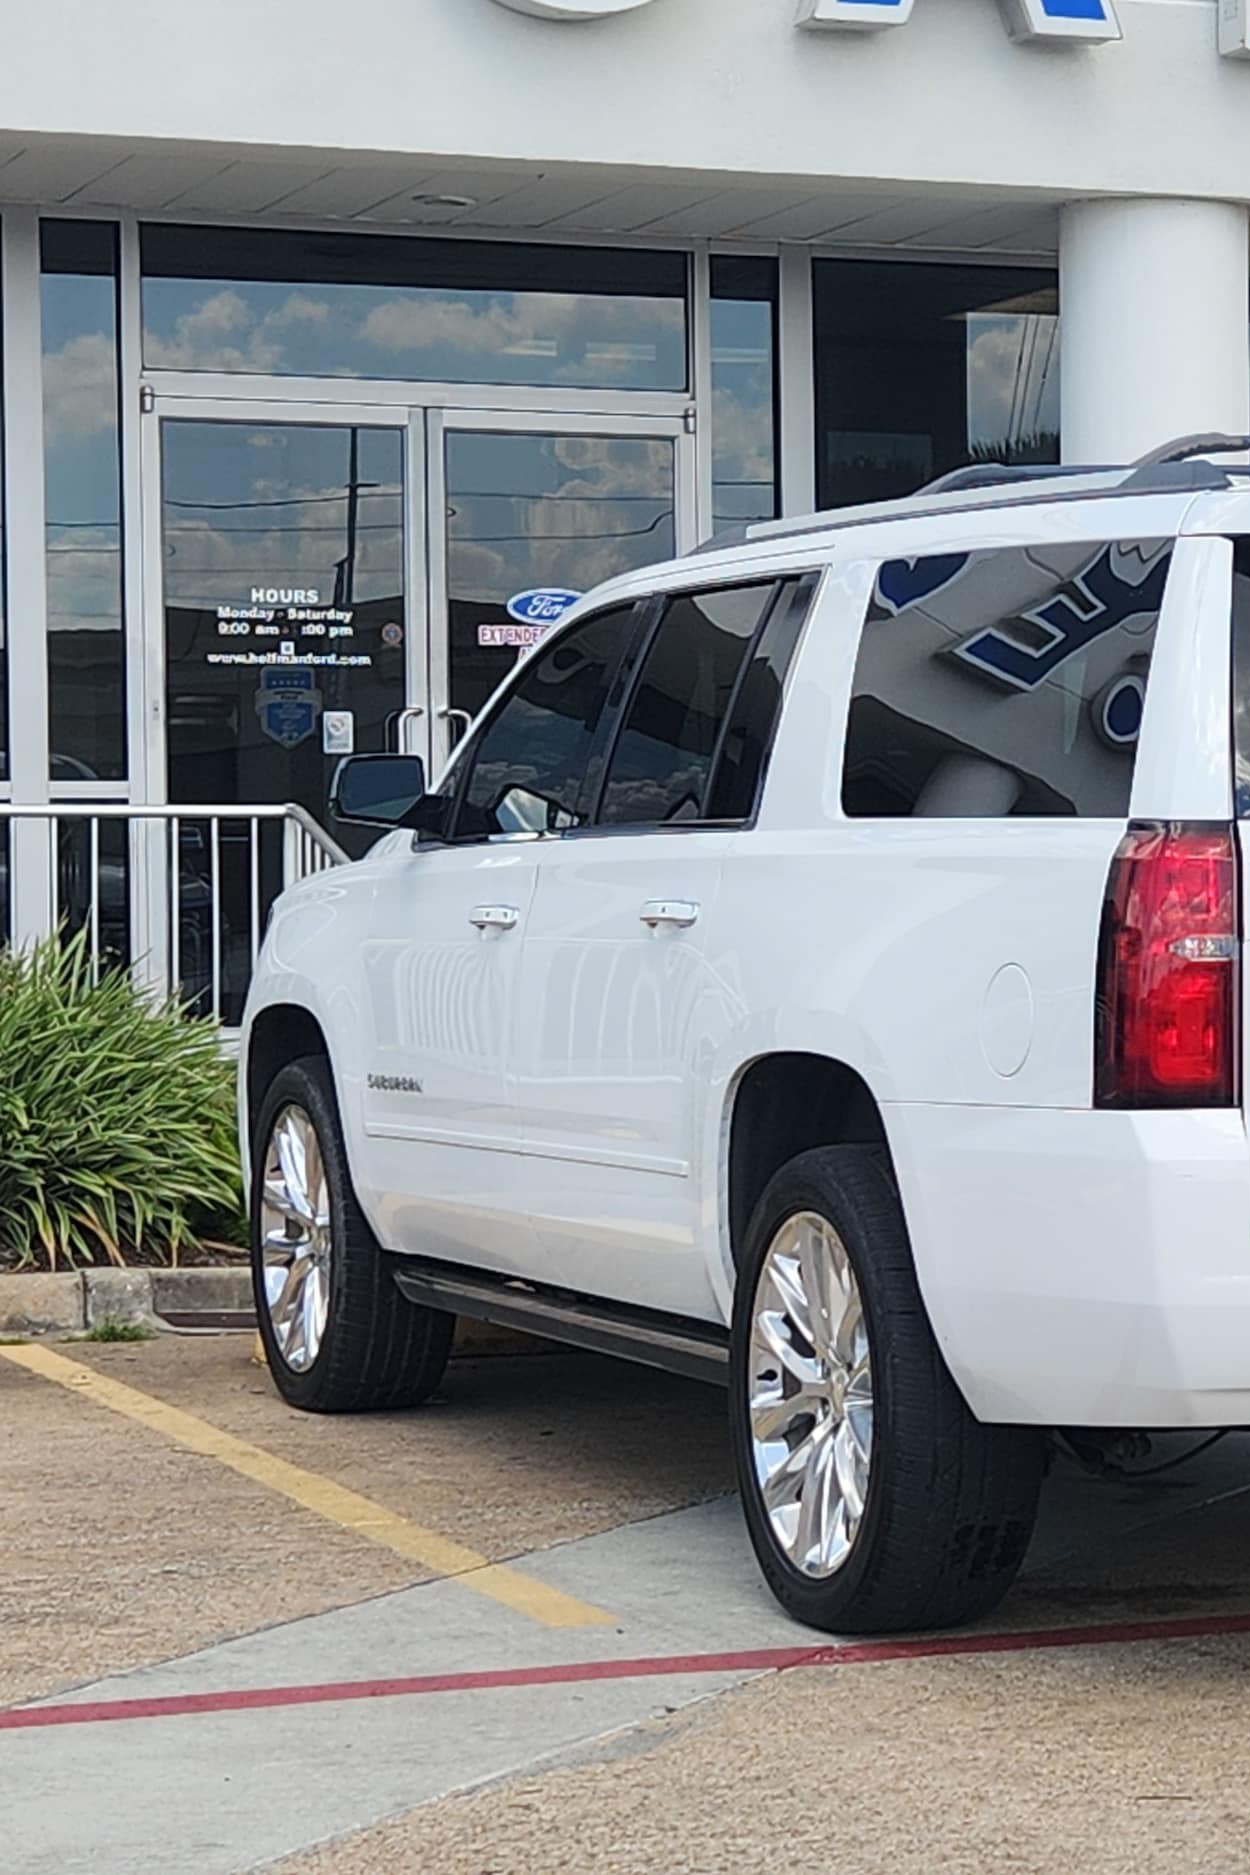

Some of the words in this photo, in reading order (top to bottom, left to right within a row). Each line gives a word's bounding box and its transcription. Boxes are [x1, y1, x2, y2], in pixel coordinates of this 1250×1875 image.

[251, 588, 319, 603] HOURS
[526, 594, 567, 617] For
[217, 607, 275, 621] Monday
[287, 608, 353, 623] Saturday
[328, 625, 353, 638] pm
